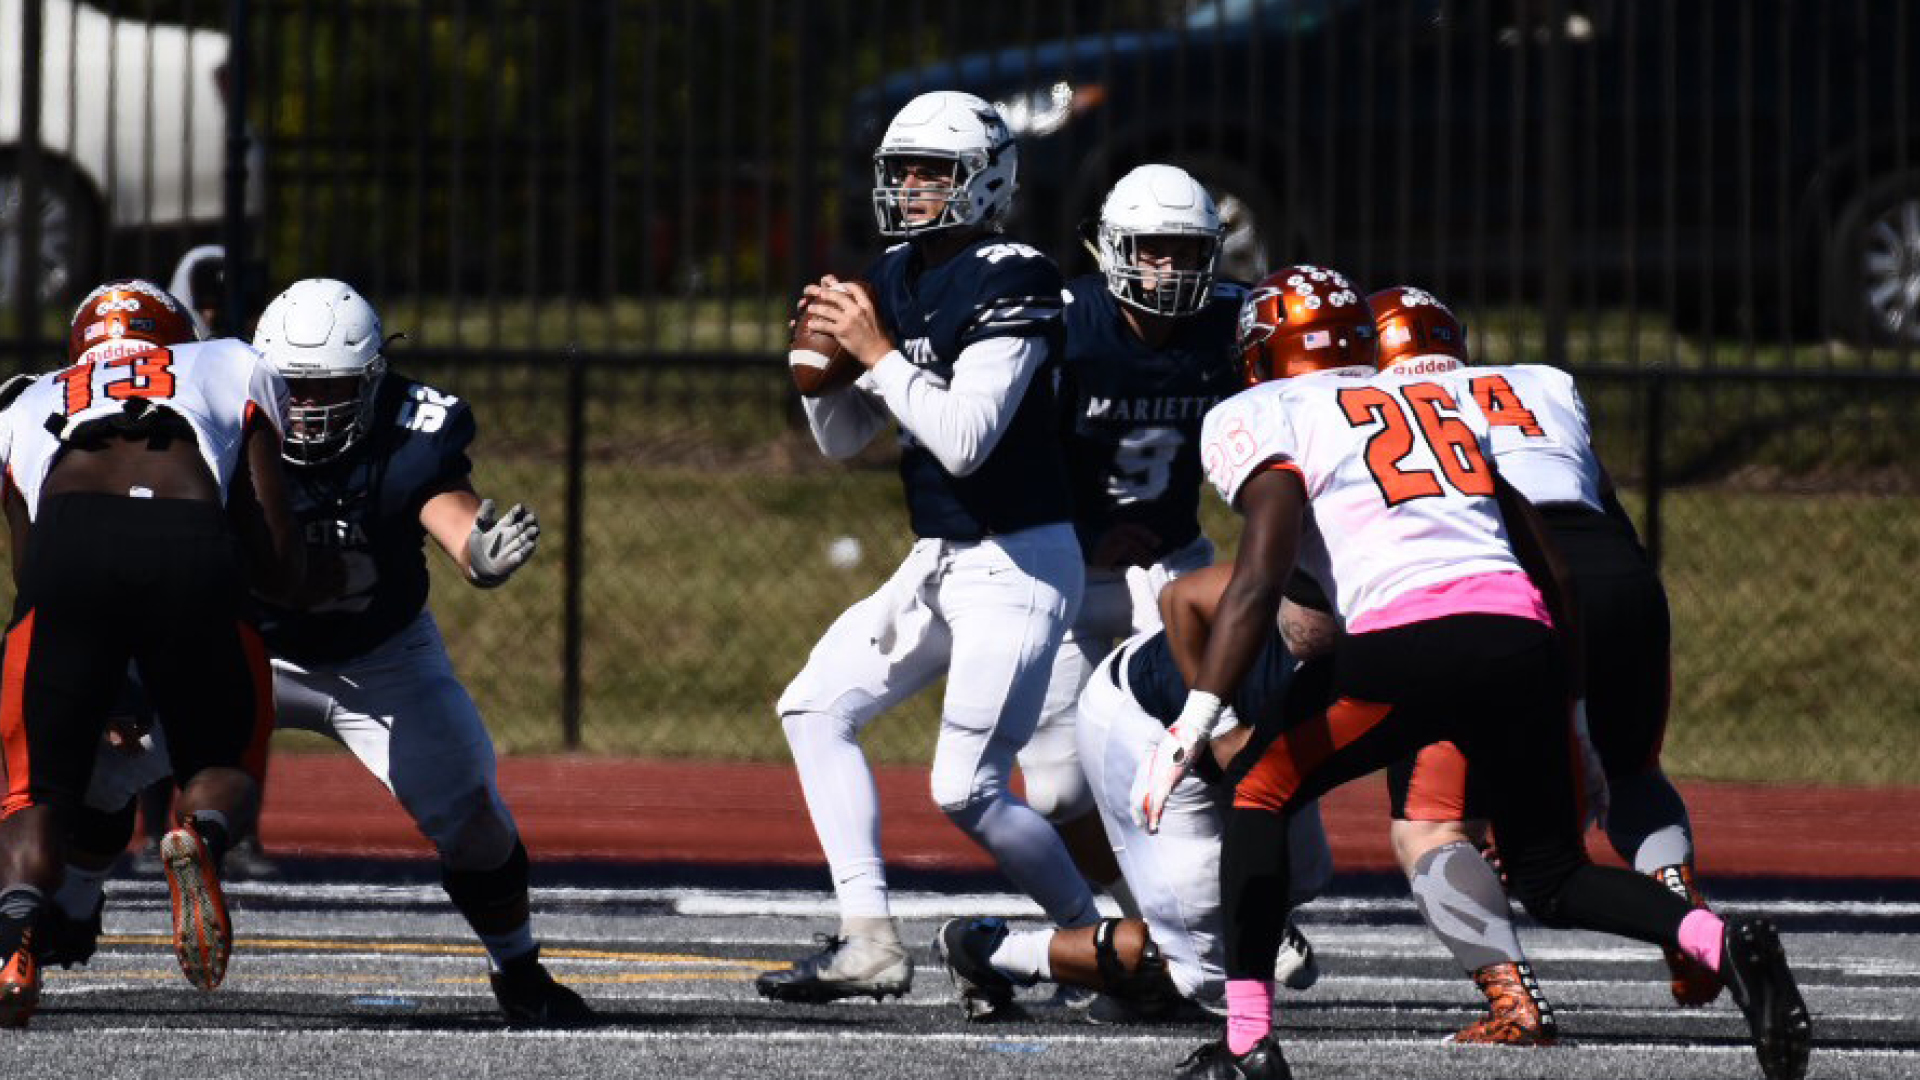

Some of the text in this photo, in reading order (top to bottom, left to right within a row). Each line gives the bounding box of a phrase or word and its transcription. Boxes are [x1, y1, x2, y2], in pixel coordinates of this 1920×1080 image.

[52, 348, 175, 417] 13
[1087, 396, 1226, 419] MARIETT
[1107, 427, 1184, 504] 9
[1336, 382, 1495, 508] 26
